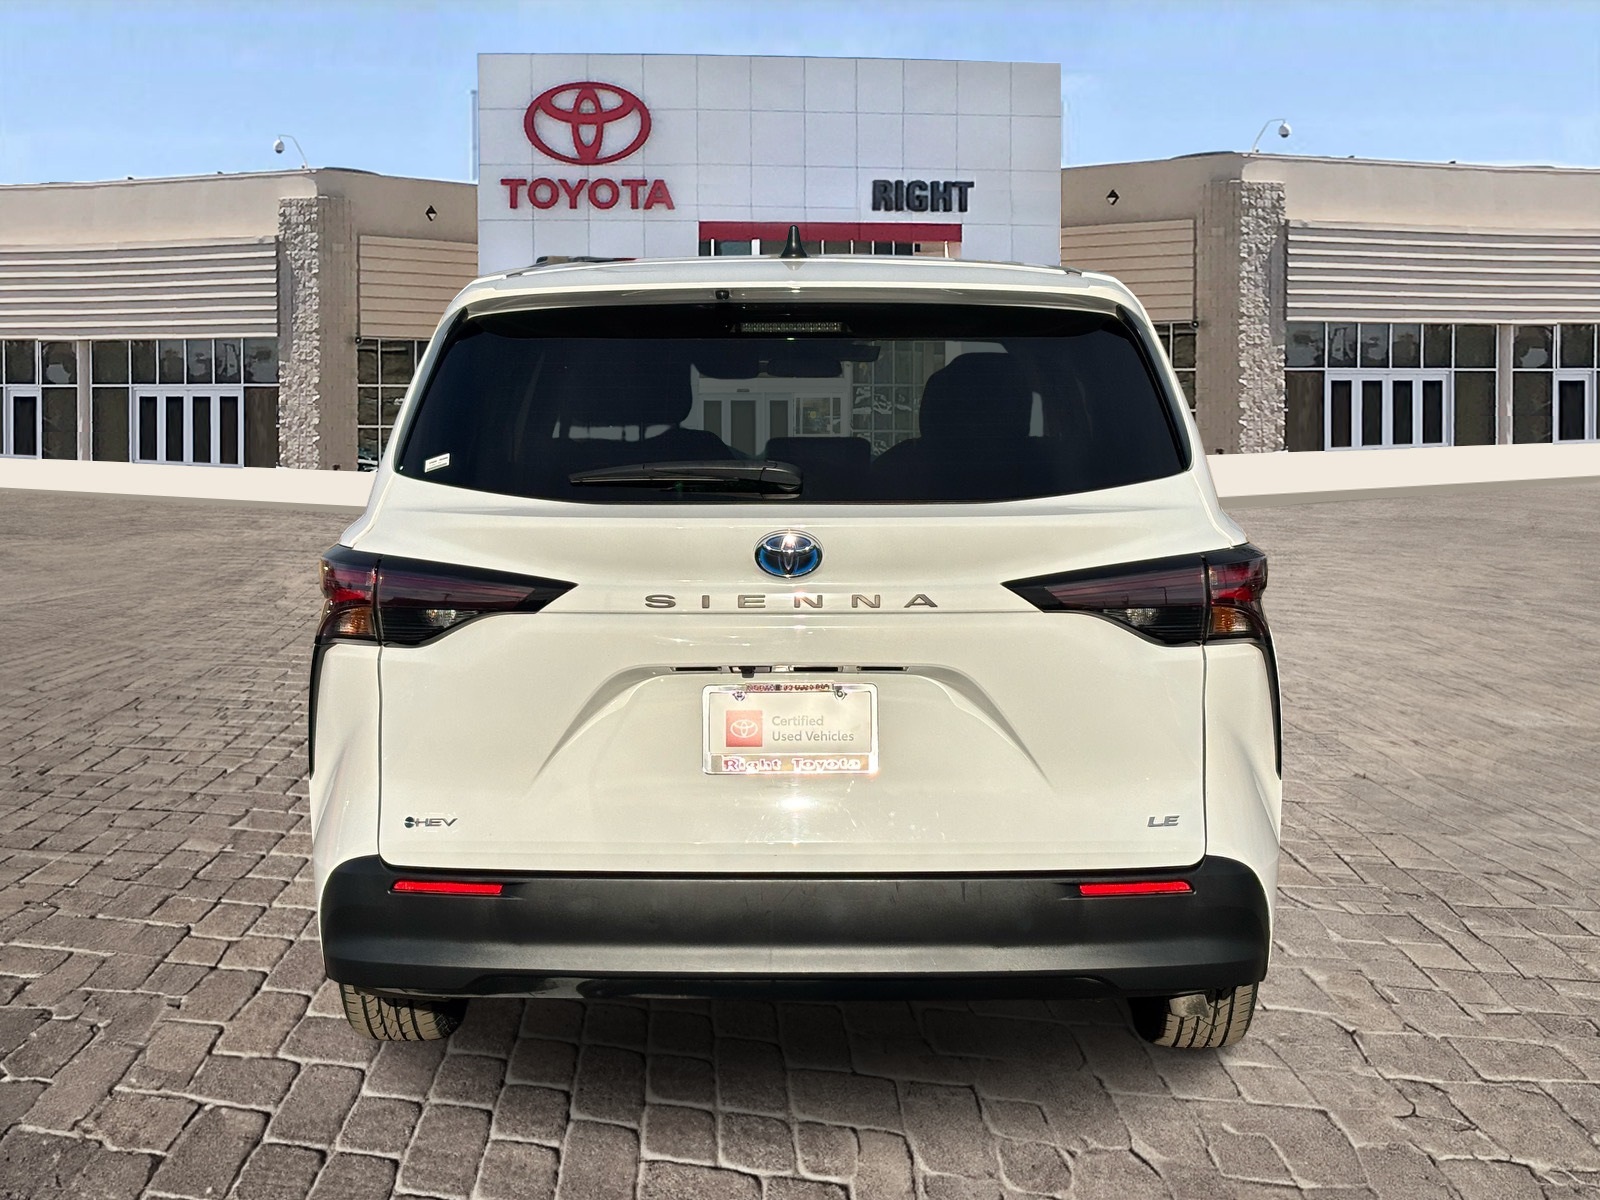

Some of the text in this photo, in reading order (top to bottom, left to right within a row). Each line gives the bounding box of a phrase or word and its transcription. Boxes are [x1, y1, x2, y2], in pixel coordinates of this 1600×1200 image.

[500, 178, 675, 210] TOYOTA
[872, 179, 975, 212] RIGHT
[644, 593, 938, 609] SIENNA
[771, 715, 824, 727] Certified
[771, 730, 854, 742] Used Vehicles
[723, 756, 862, 773] Right Toyota
[414, 817, 458, 828] HEV
[1147, 815, 1180, 828] LE
